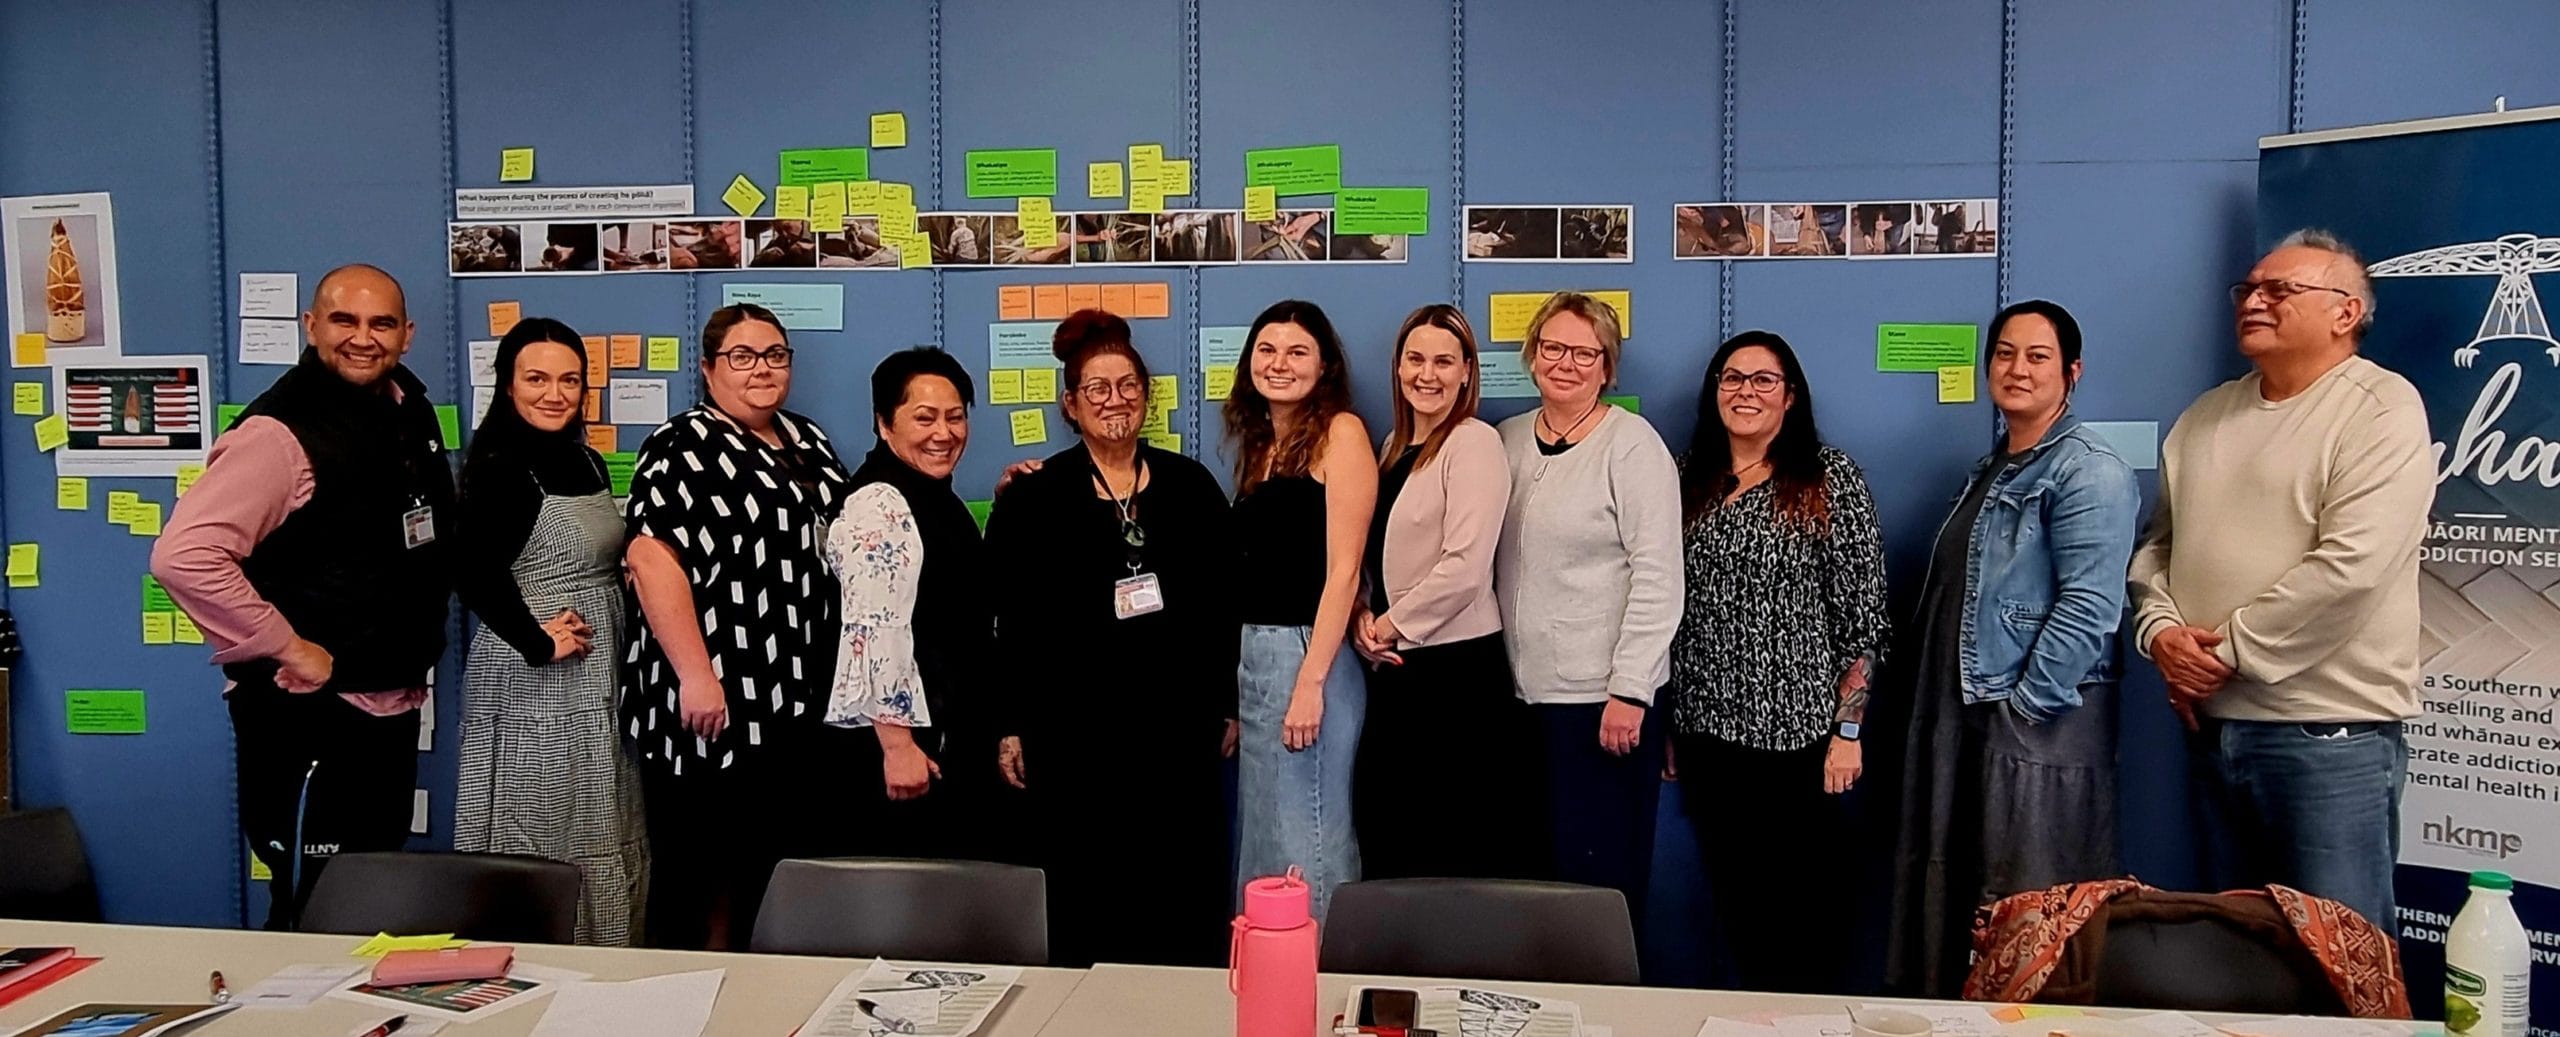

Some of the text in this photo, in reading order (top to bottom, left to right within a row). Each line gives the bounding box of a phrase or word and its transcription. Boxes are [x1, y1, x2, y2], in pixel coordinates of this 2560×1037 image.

[479, 194, 510, 203] happens
[512, 194, 535, 202] during
[551, 193, 578, 202] process
[589, 191, 619, 200] creating
[2493, 526, 2560, 544] MENT
[2530, 551, 2560, 568] SE
[2424, 675, 2435, 688] a
[2442, 674, 2542, 698] Southern
[2423, 700, 2553, 724] nselling and
[2401, 722, 2437, 737] and
[2443, 725, 2530, 747] whānau
[2408, 747, 2460, 764] erate
[2476, 776, 2546, 800] health
[2422, 814, 2523, 859] nkmp
[2402, 926, 2447, 944] ADDI
